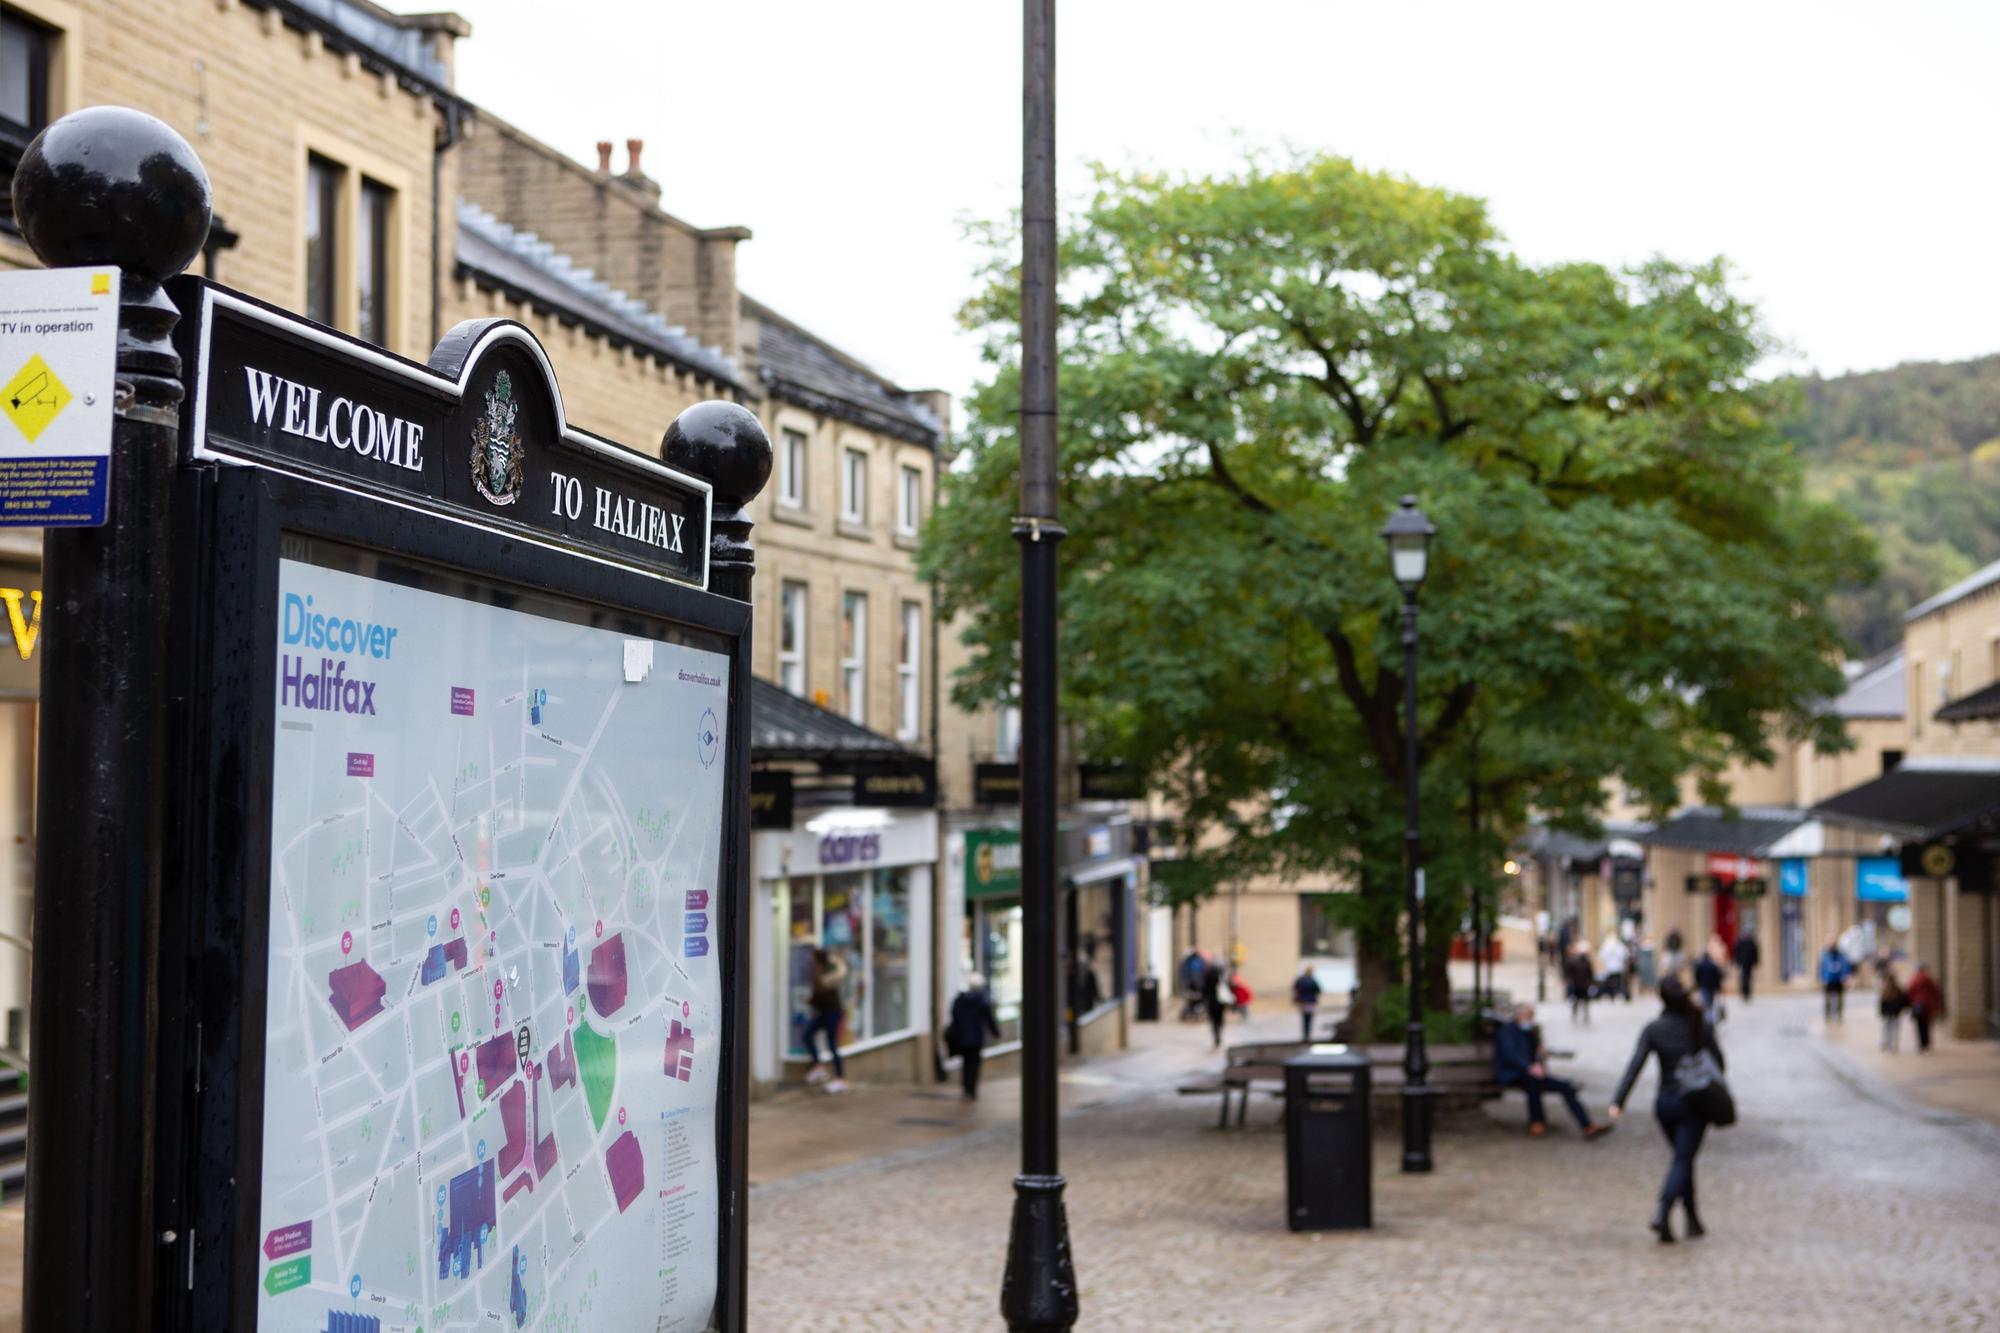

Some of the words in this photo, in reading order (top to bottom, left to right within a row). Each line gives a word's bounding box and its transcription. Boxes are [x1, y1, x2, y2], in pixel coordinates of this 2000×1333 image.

[20, 322, 31, 334] in
[35, 320, 93, 336] operation
[244, 365, 424, 472] WELCOME
[551, 472, 583, 520] TO
[593, 486, 685, 554] HALIFAX
[284, 592, 398, 659] Discover
[281, 654, 376, 717] Halifax
